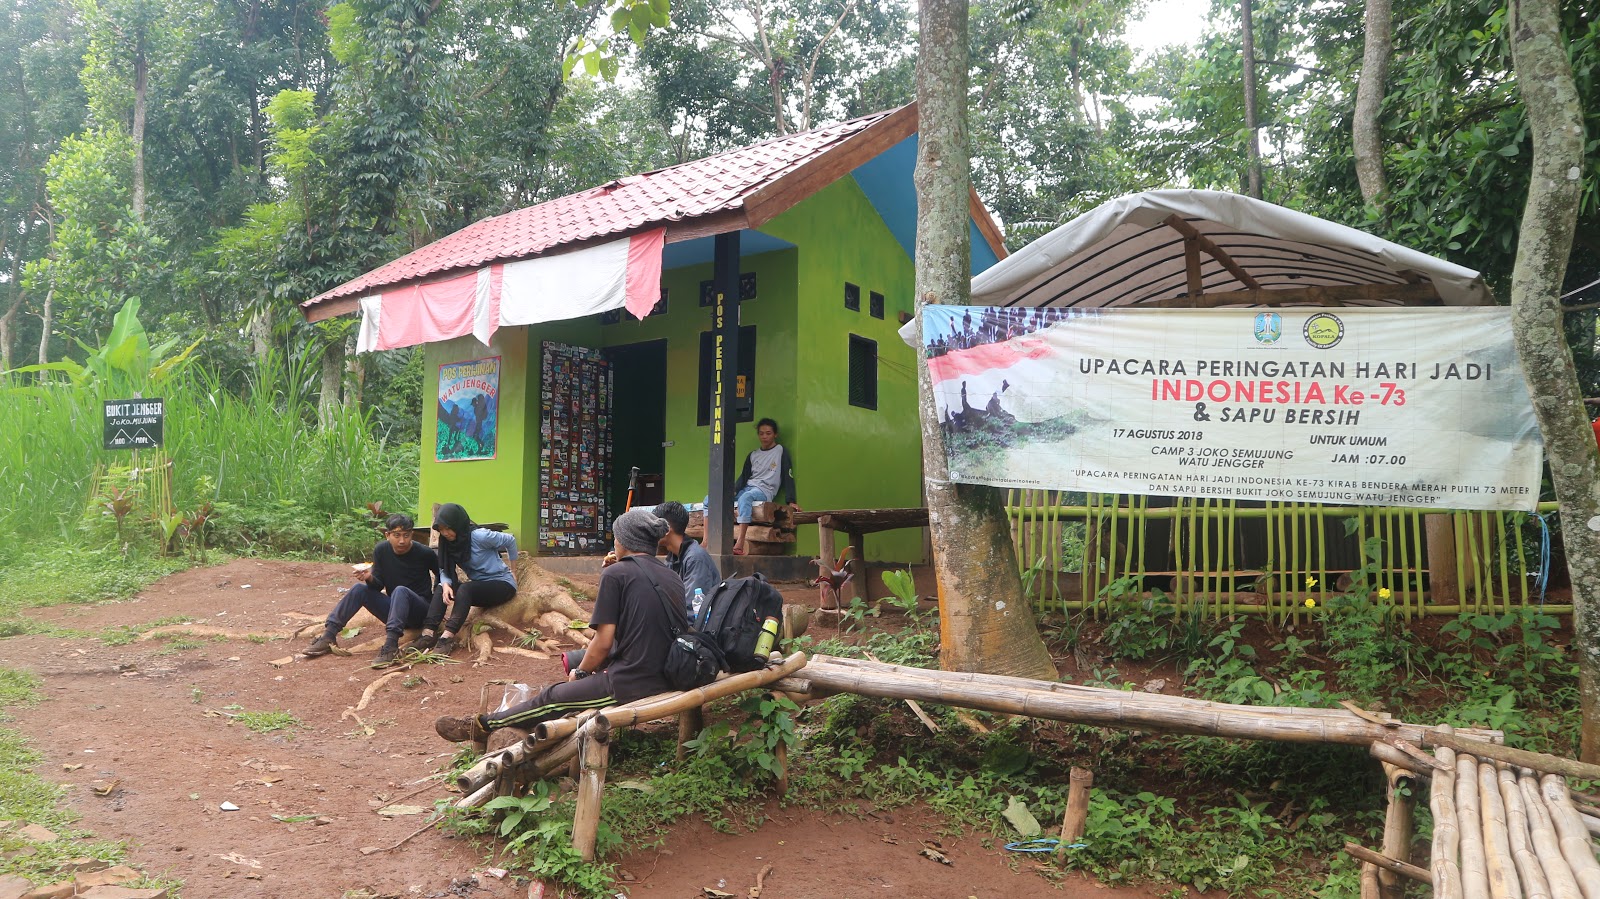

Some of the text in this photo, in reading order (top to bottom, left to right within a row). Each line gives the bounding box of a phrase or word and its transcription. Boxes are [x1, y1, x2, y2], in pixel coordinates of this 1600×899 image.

[442, 367, 457, 380] POS
[713, 293, 724, 444] POS PERIJINAN
[1079, 358, 1491, 381] UPACARA PERINGATAN HARI JADI
[441, 379, 497, 404] WATU JENGGER
[1152, 378, 1326, 405] INDONESIA
[106, 402, 162, 417] BUKIT JENGGER
[1193, 401, 1361, 426] & SAPU BERSIH
[1112, 428, 1203, 441] 17 AGUSTUS 2018
[1309, 434, 1387, 447] UNTUK UMUM
[1151, 446, 1294, 460] CAMP 3 JOKO SEMUJUNG
[1331, 453, 1360, 464] JAM
[1179, 457, 1265, 469] WATU JENGGER
[1123, 471, 1182, 482] PERINGATAN
[1186, 474, 1209, 483] HARI
[1211, 475, 1234, 484] JADI
[1237, 476, 1292, 486] INDONESIA
[1296, 478, 1324, 488] KE-73
[1328, 480, 1358, 489] KIRAB
[1361, 481, 1408, 491] BENDERA
[1411, 483, 1447, 493] MERAH
[1451, 485, 1480, 494] PUTIH
[1484, 485, 1497, 494] 73
[1500, 486, 1530, 495] METER
[1149, 483, 1169, 492] DAN
[1172, 485, 1197, 493] SAPU
[1200, 486, 1232, 495] BERSIH
[1236, 487, 1262, 496] BUKIT
[1266, 489, 1294, 498] JOKO
[1297, 490, 1351, 500] SEMUJUNG
[1355, 492, 1384, 502] WATU
